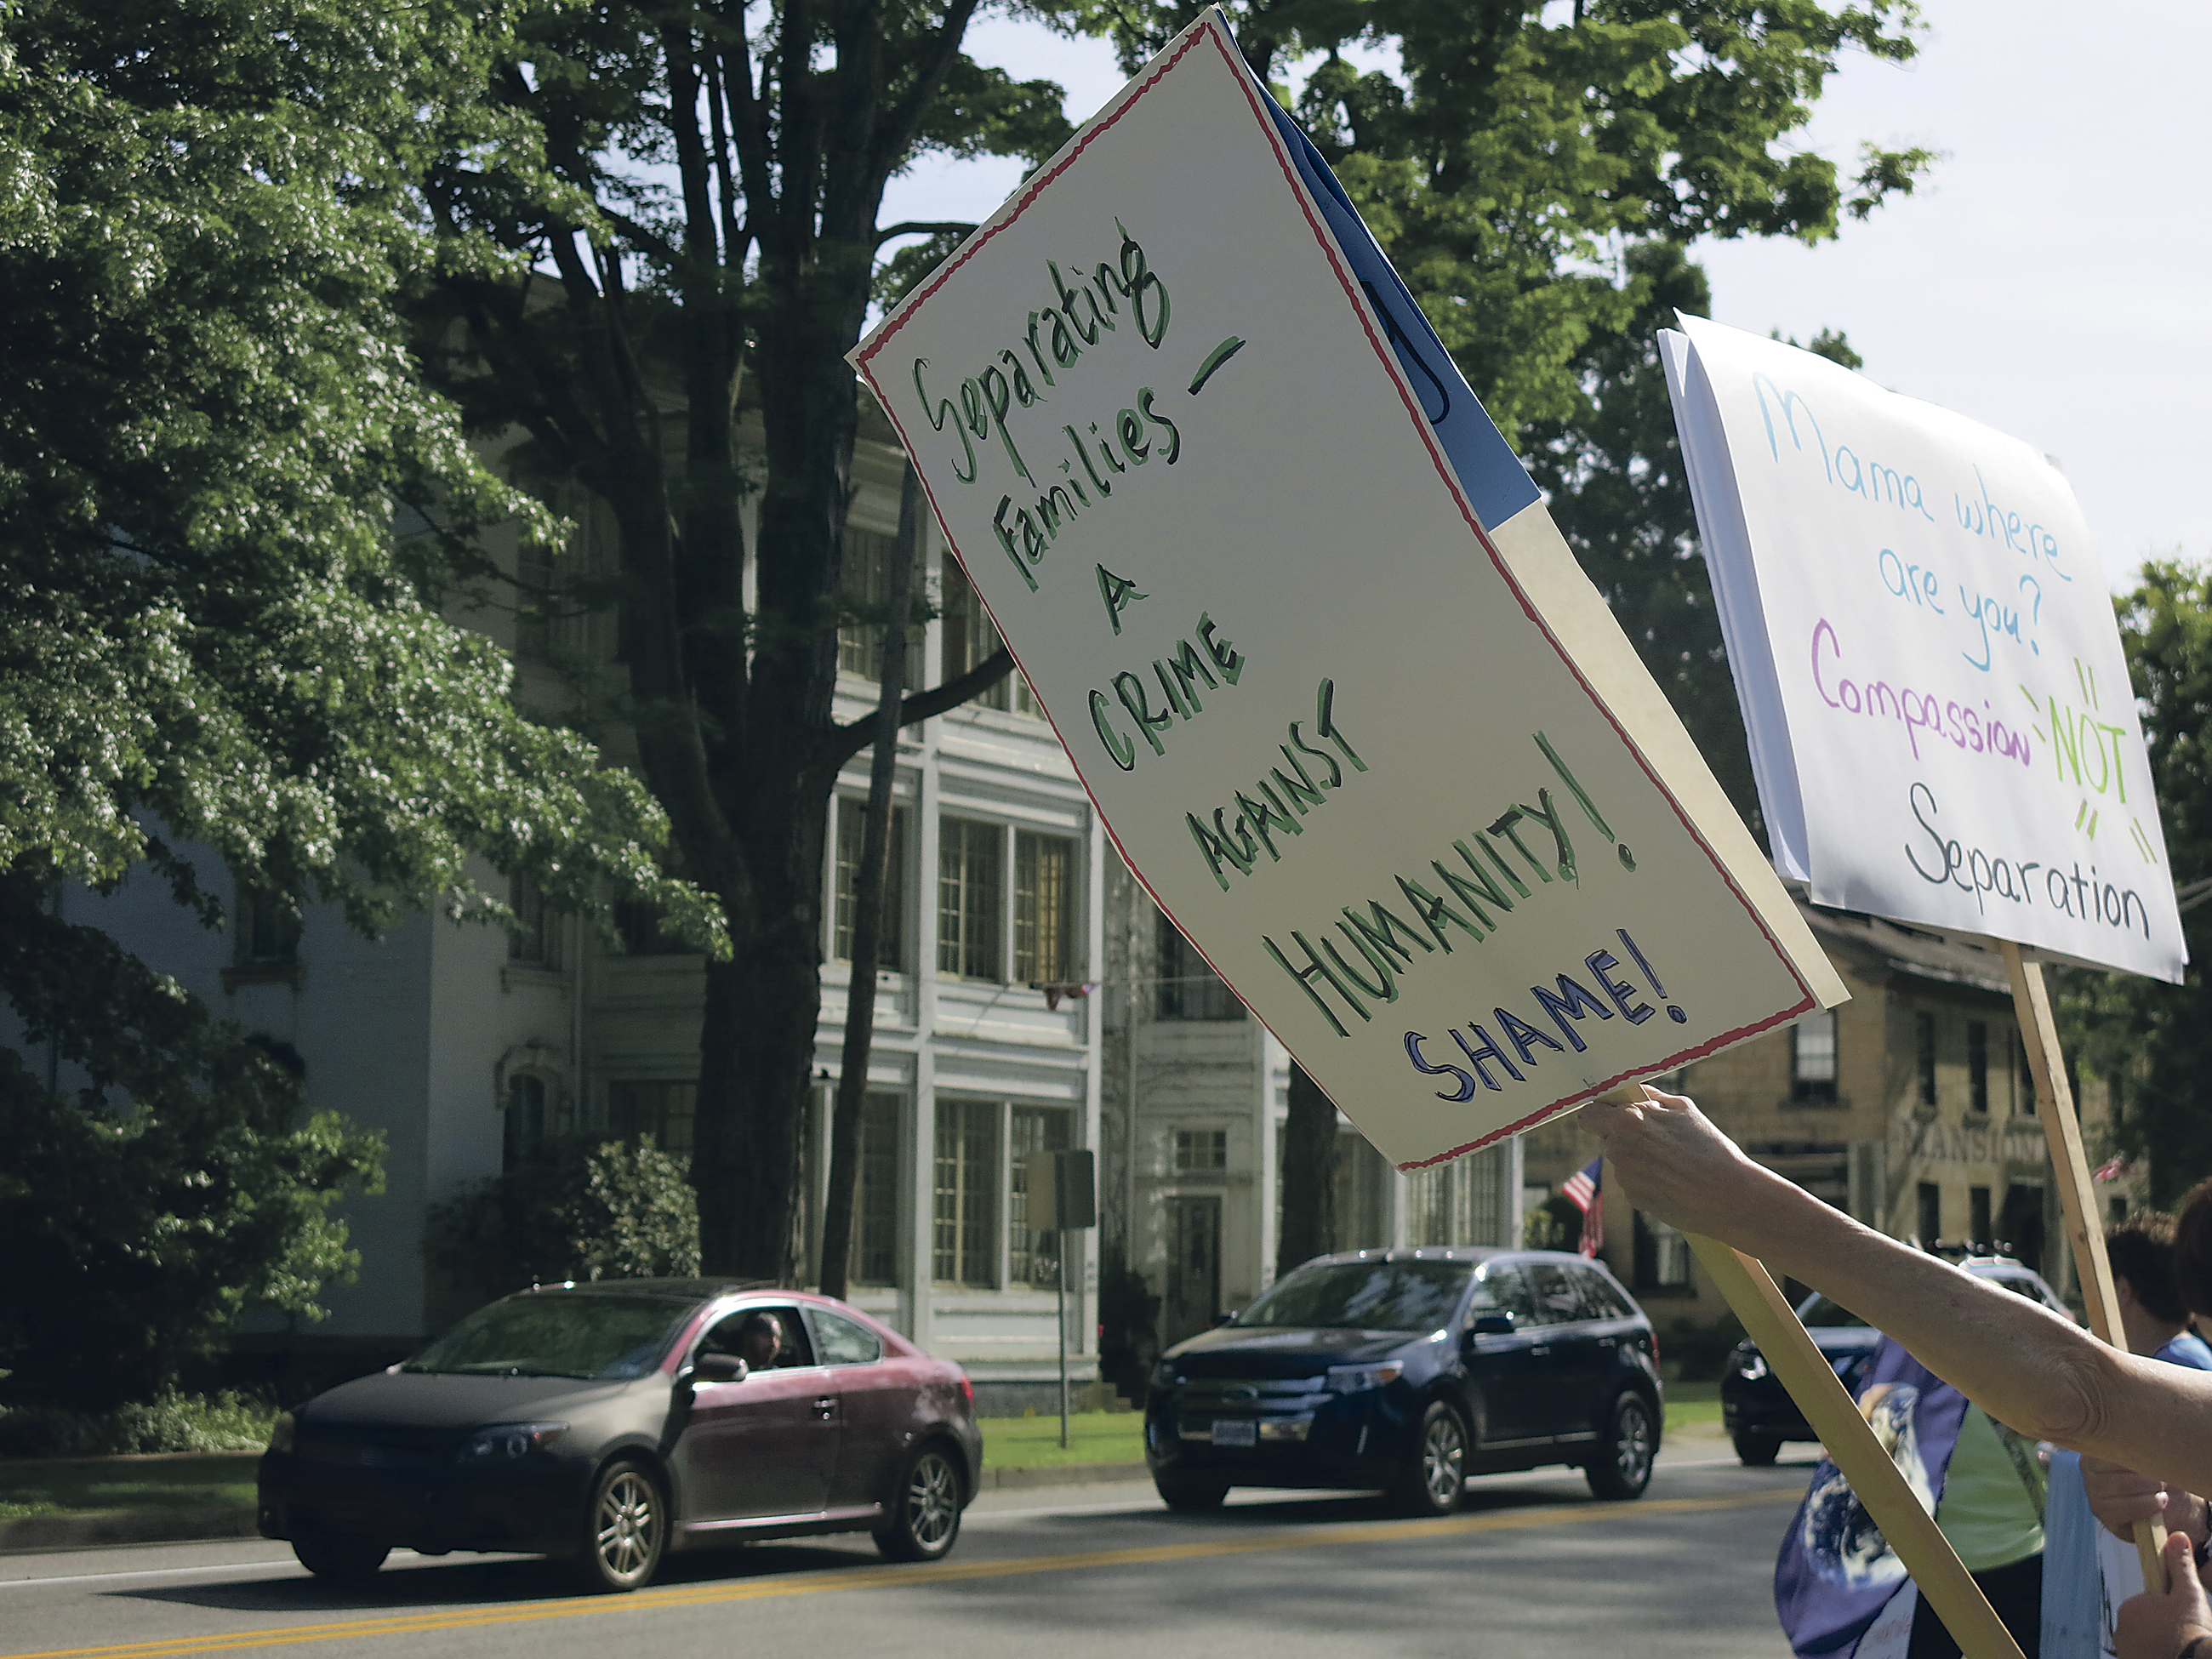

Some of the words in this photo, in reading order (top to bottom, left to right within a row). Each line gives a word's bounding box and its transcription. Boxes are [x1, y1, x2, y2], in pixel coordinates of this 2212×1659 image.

[912, 216, 1172, 488] Separating
[993, 386, 1182, 593] Families
[1752, 371, 1936, 522] Mama
[1953, 462, 2072, 582] where
[1088, 610, 1246, 772] CRIME
[1094, 562, 1150, 636] A
[1878, 547, 1945, 616] are
[1958, 573, 2042, 672] you?
[1186, 677, 1370, 893] AGAINST
[1810, 617, 2032, 767] Compassion
[2048, 695, 2128, 804] NOT
[1261, 729, 1637, 1038] HUMANITY!
[1903, 781, 2151, 941] Separation
[1402, 928, 1688, 1104] SHAME!
